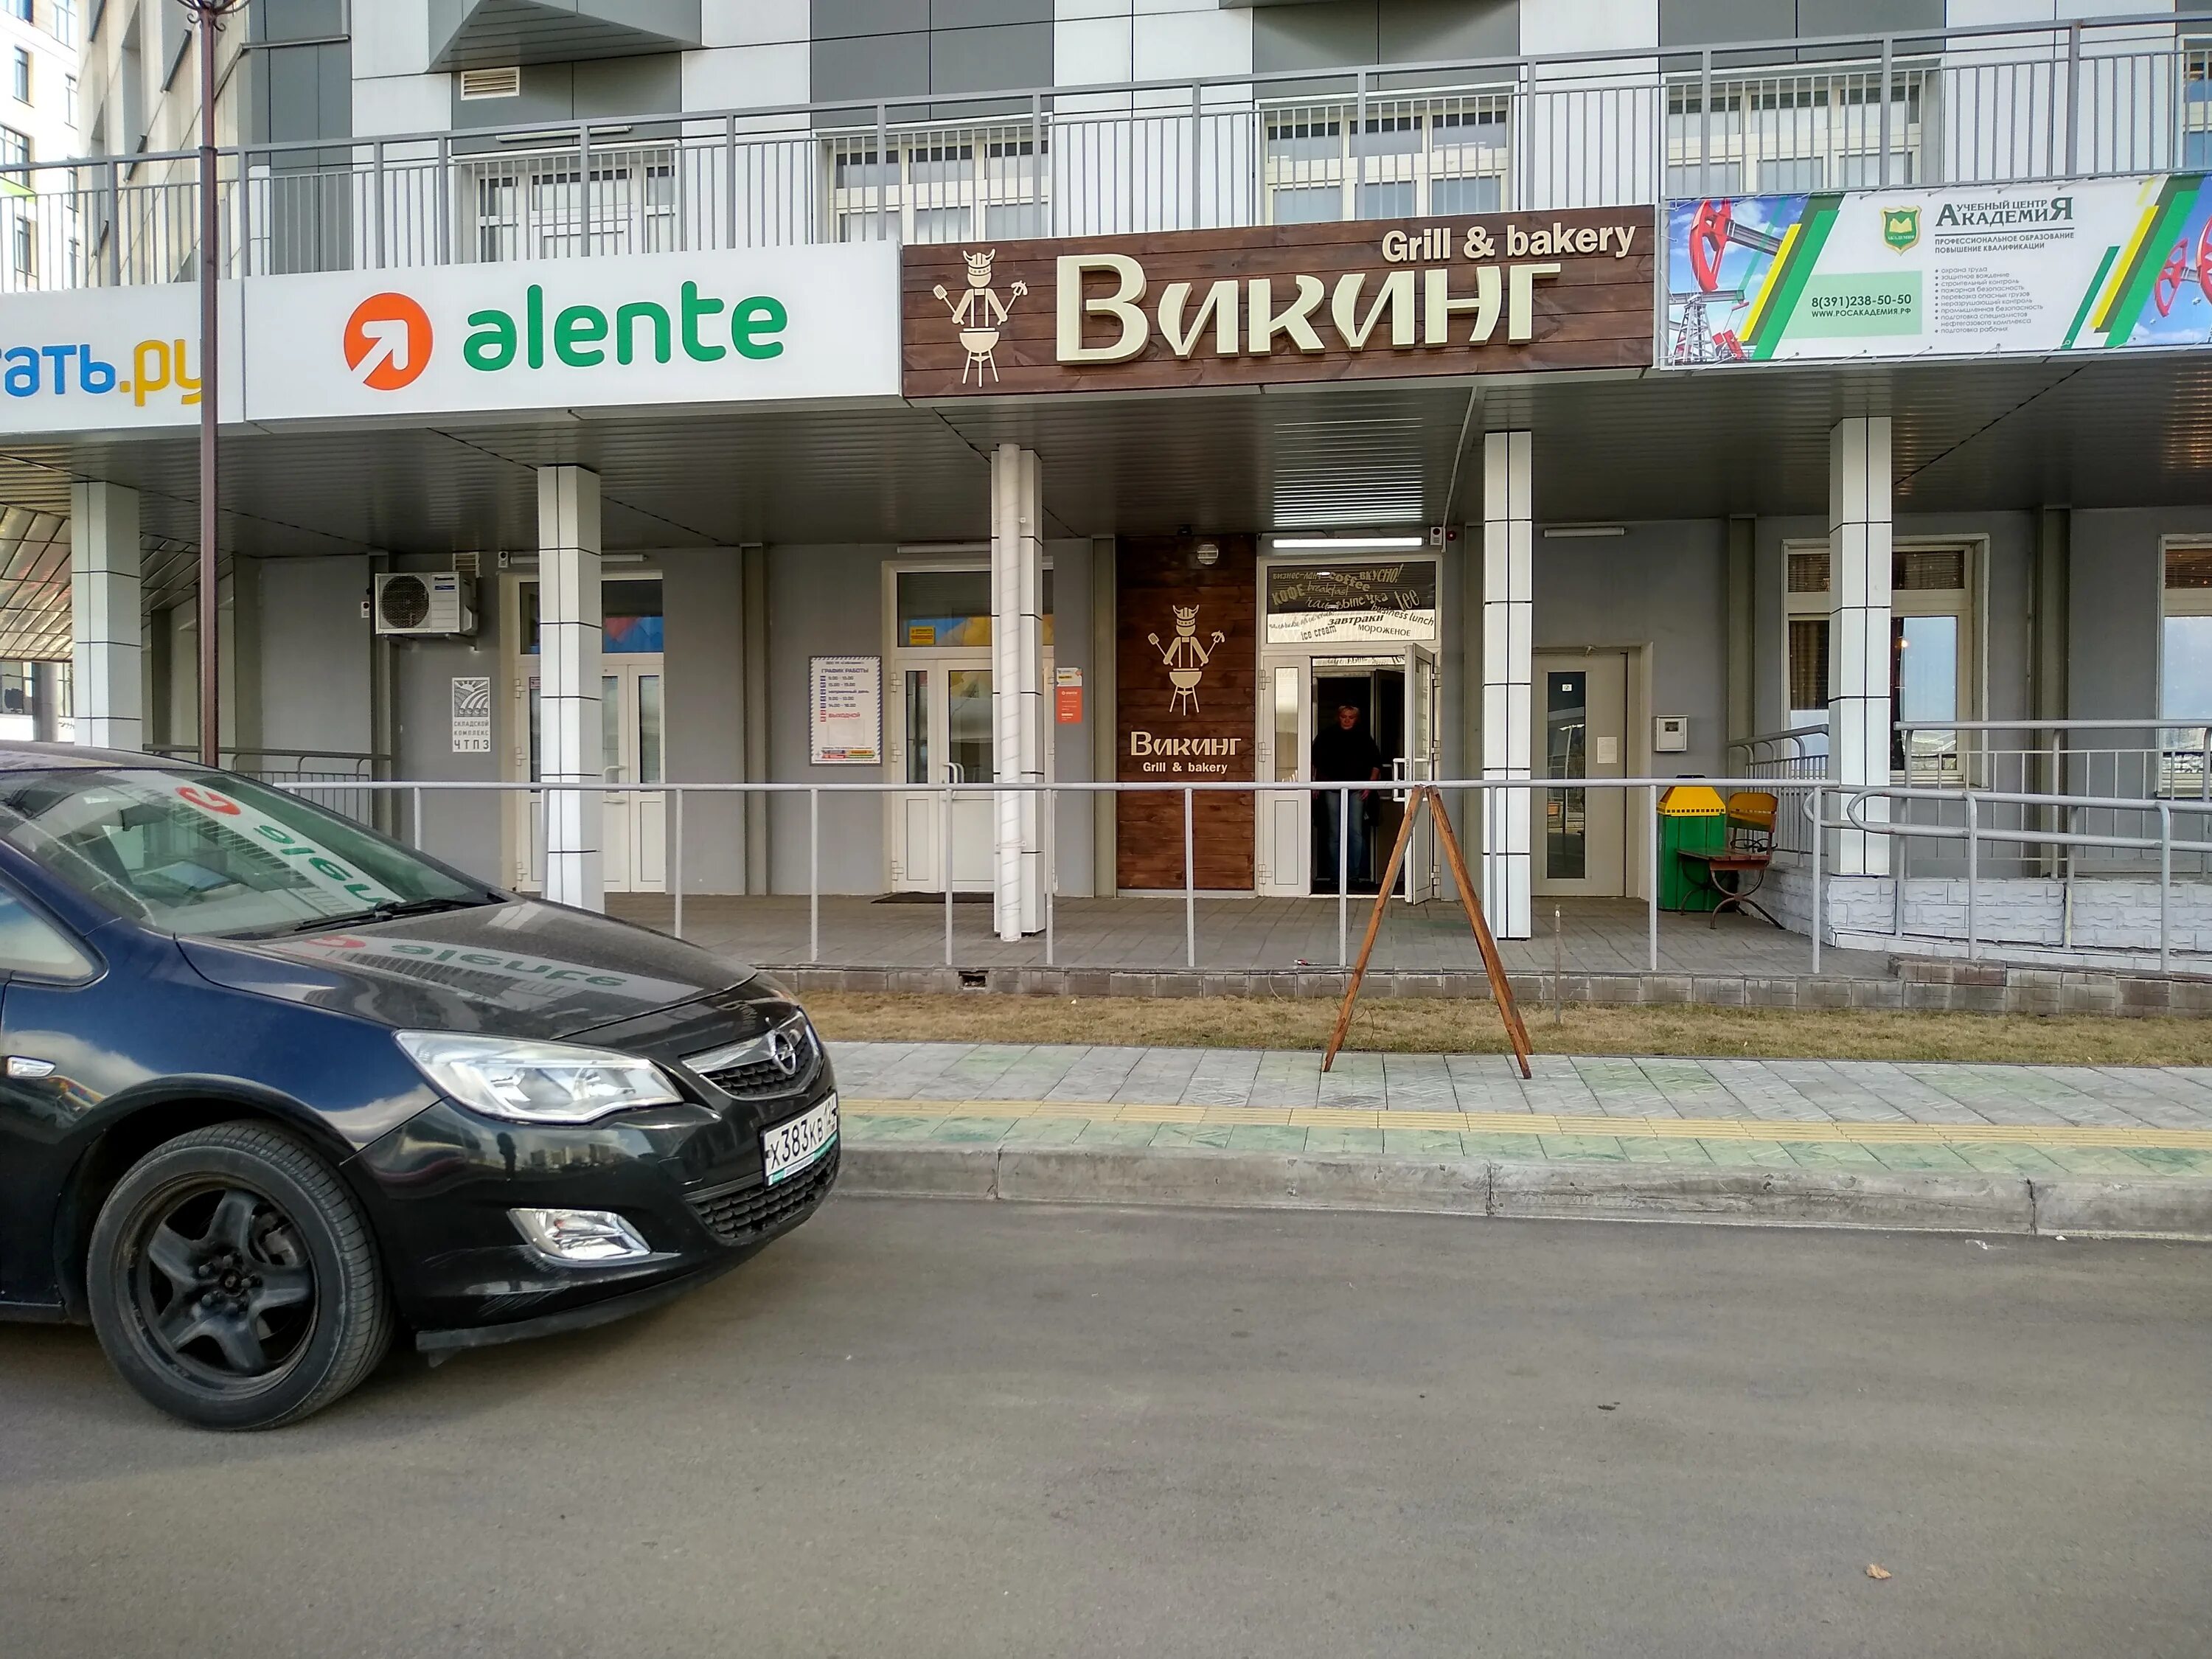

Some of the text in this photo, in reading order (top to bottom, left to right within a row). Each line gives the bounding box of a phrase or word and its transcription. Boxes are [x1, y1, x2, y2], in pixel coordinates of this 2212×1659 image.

[1956, 199, 2048, 212] УЧЕБНЫЙ ЦЕНТР
[1382, 222, 1636, 262] Grill & bakery
[1935, 232, 2075, 245] ПРОФЕССИОНАЛЬНОЕ ОБРАЗОВАНИЕ
[1935, 243, 2045, 254] ПОВЫШЕНИЕ КВАЛИФИКАЦИИ
[1055, 253, 1561, 365] Викинг
[1812, 294, 1912, 309] 8(391)238-50-50
[463, 280, 788, 372] alente
[0, 338, 201, 406] ать.ру
[1359, 563, 1404, 583] ВКУСНО!
[1272, 583, 1305, 605] КОФЕ
[1307, 580, 1349, 597] breakfast
[1394, 589, 1420, 612] tee
[1327, 615, 1384, 625] завтраки
[1371, 602, 1434, 626] business lunch
[1314, 625, 1337, 637] cream
[454, 740, 489, 749] ЧТПЗ
[1131, 731, 1241, 756] Викинг
[1143, 762, 1228, 774] Grill & bakery
